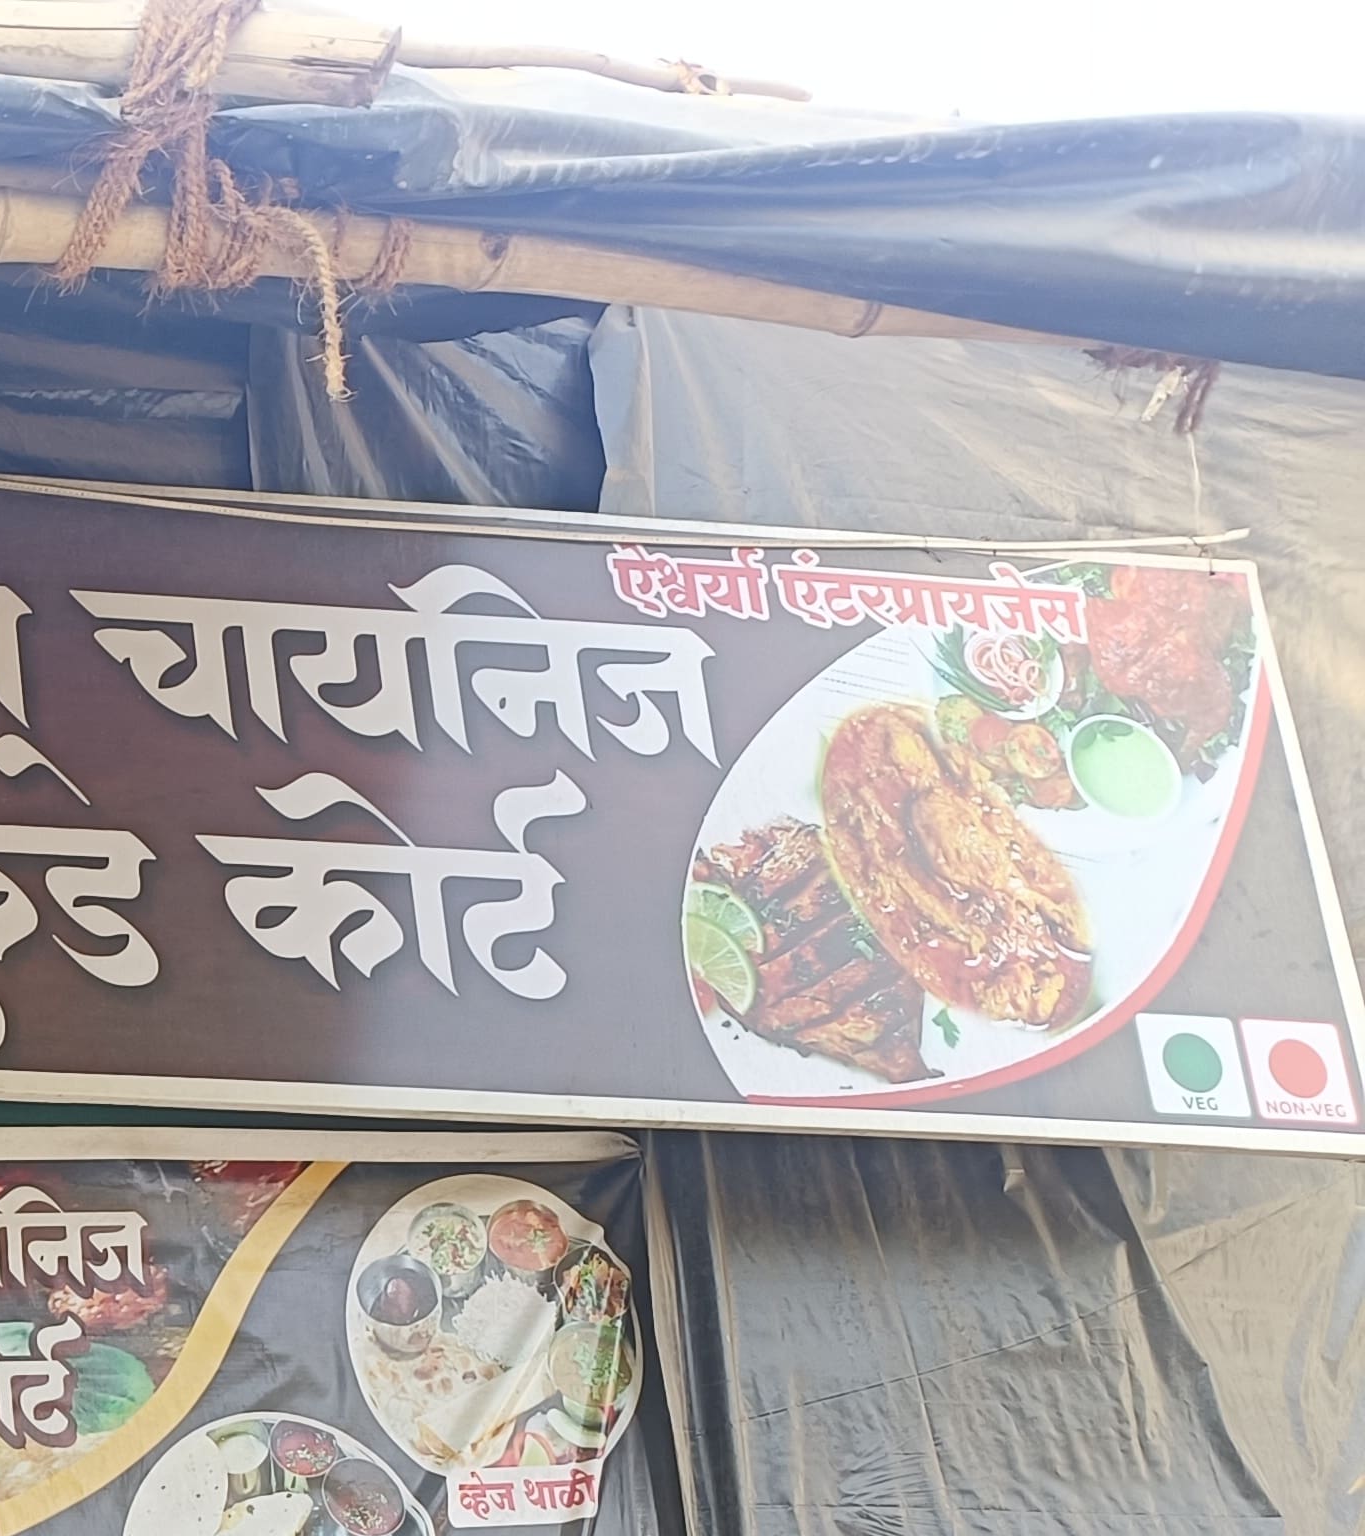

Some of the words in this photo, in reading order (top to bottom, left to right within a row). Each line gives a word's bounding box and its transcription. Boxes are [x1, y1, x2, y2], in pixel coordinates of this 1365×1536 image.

[70, 564, 720, 767] चायनिज
[196, 771, 585, 999] कोर्ट
[1182, 1096, 1218, 1111] VEG
[1266, 1101, 1347, 1118] NON-VEG
[458, 1471, 516, 1520] व्हेज
[523, 1468, 596, 1510] थाळी
